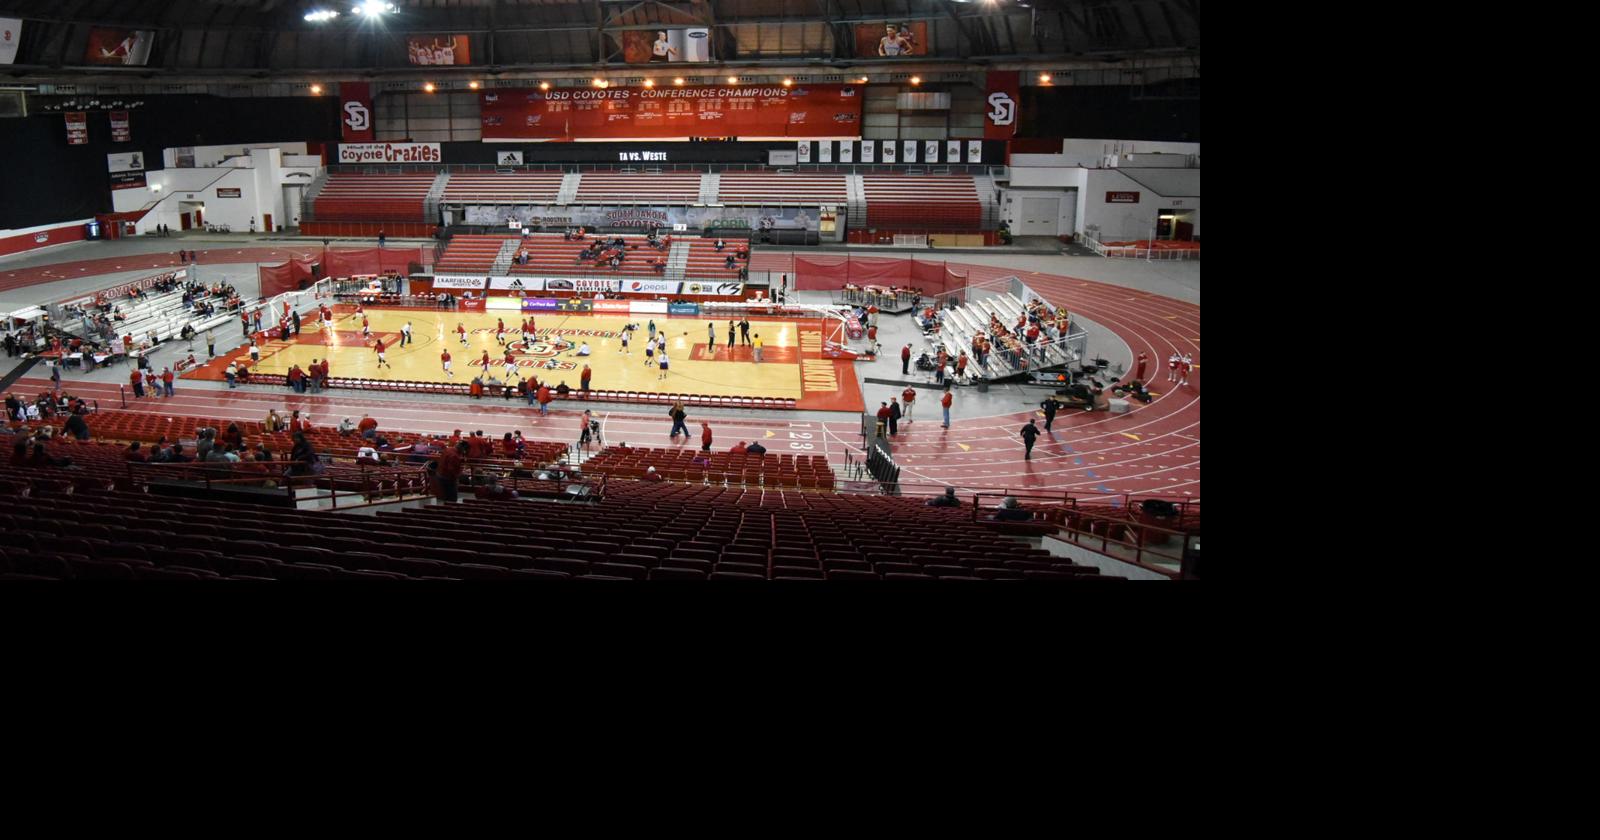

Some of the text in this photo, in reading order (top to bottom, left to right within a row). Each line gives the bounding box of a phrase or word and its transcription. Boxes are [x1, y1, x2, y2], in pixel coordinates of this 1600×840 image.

[545, 91, 569, 100] USD
[573, 90, 630, 99] COYOTES
[641, 89, 716, 98] CONFERENCE
[718, 87, 788, 97] CHAMPIONS
[341, 144, 439, 162] Coyote Crazies
[619, 152, 627, 160] TA
[576, 280, 611, 288] COYOTE
[643, 281, 668, 292] pepsi
